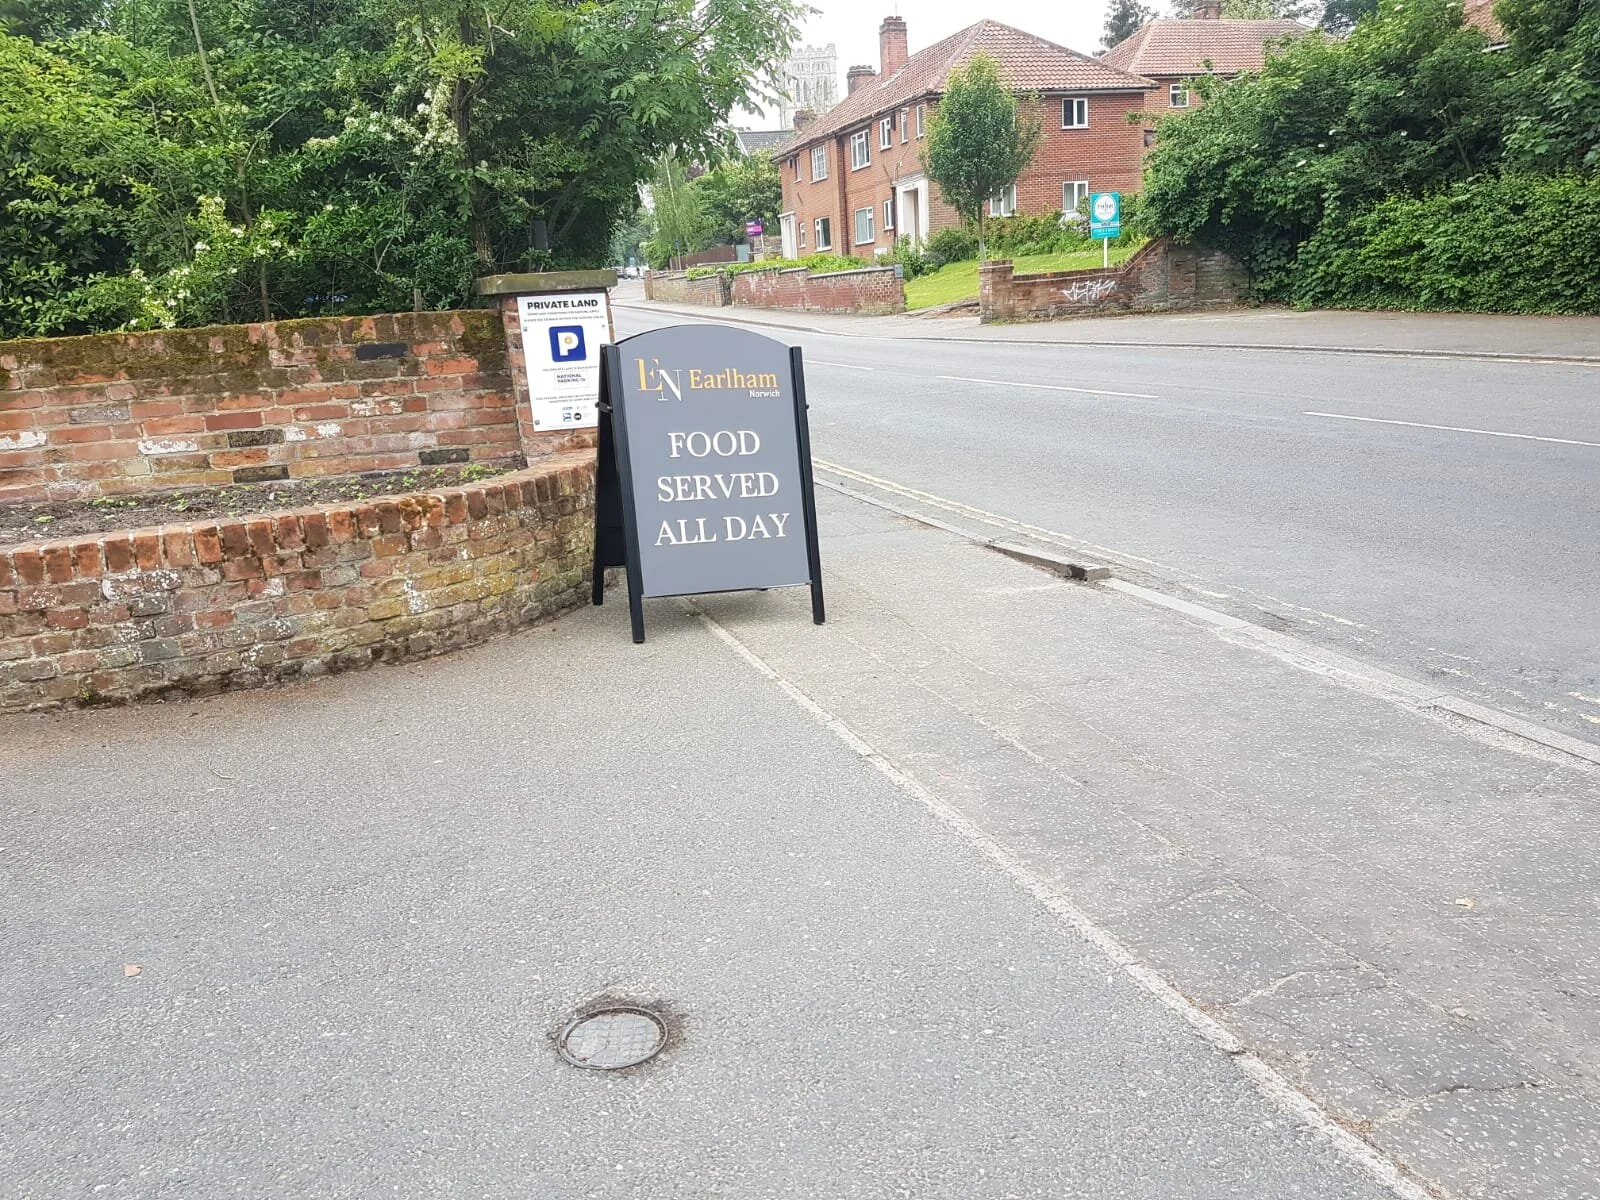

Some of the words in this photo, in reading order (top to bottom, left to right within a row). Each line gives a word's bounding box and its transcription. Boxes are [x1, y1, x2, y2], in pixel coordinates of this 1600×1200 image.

[527, 300, 569, 310] PRIVATE
[571, 299, 598, 308] LAND
[557, 331, 579, 356] P
[688, 368, 778, 389] Earlham
[749, 389, 781, 398] Norwich
[667, 430, 760, 458] FOOD
[657, 472, 779, 502] SERVED
[654, 518, 717, 546] ALL
[723, 512, 790, 541] DAY
